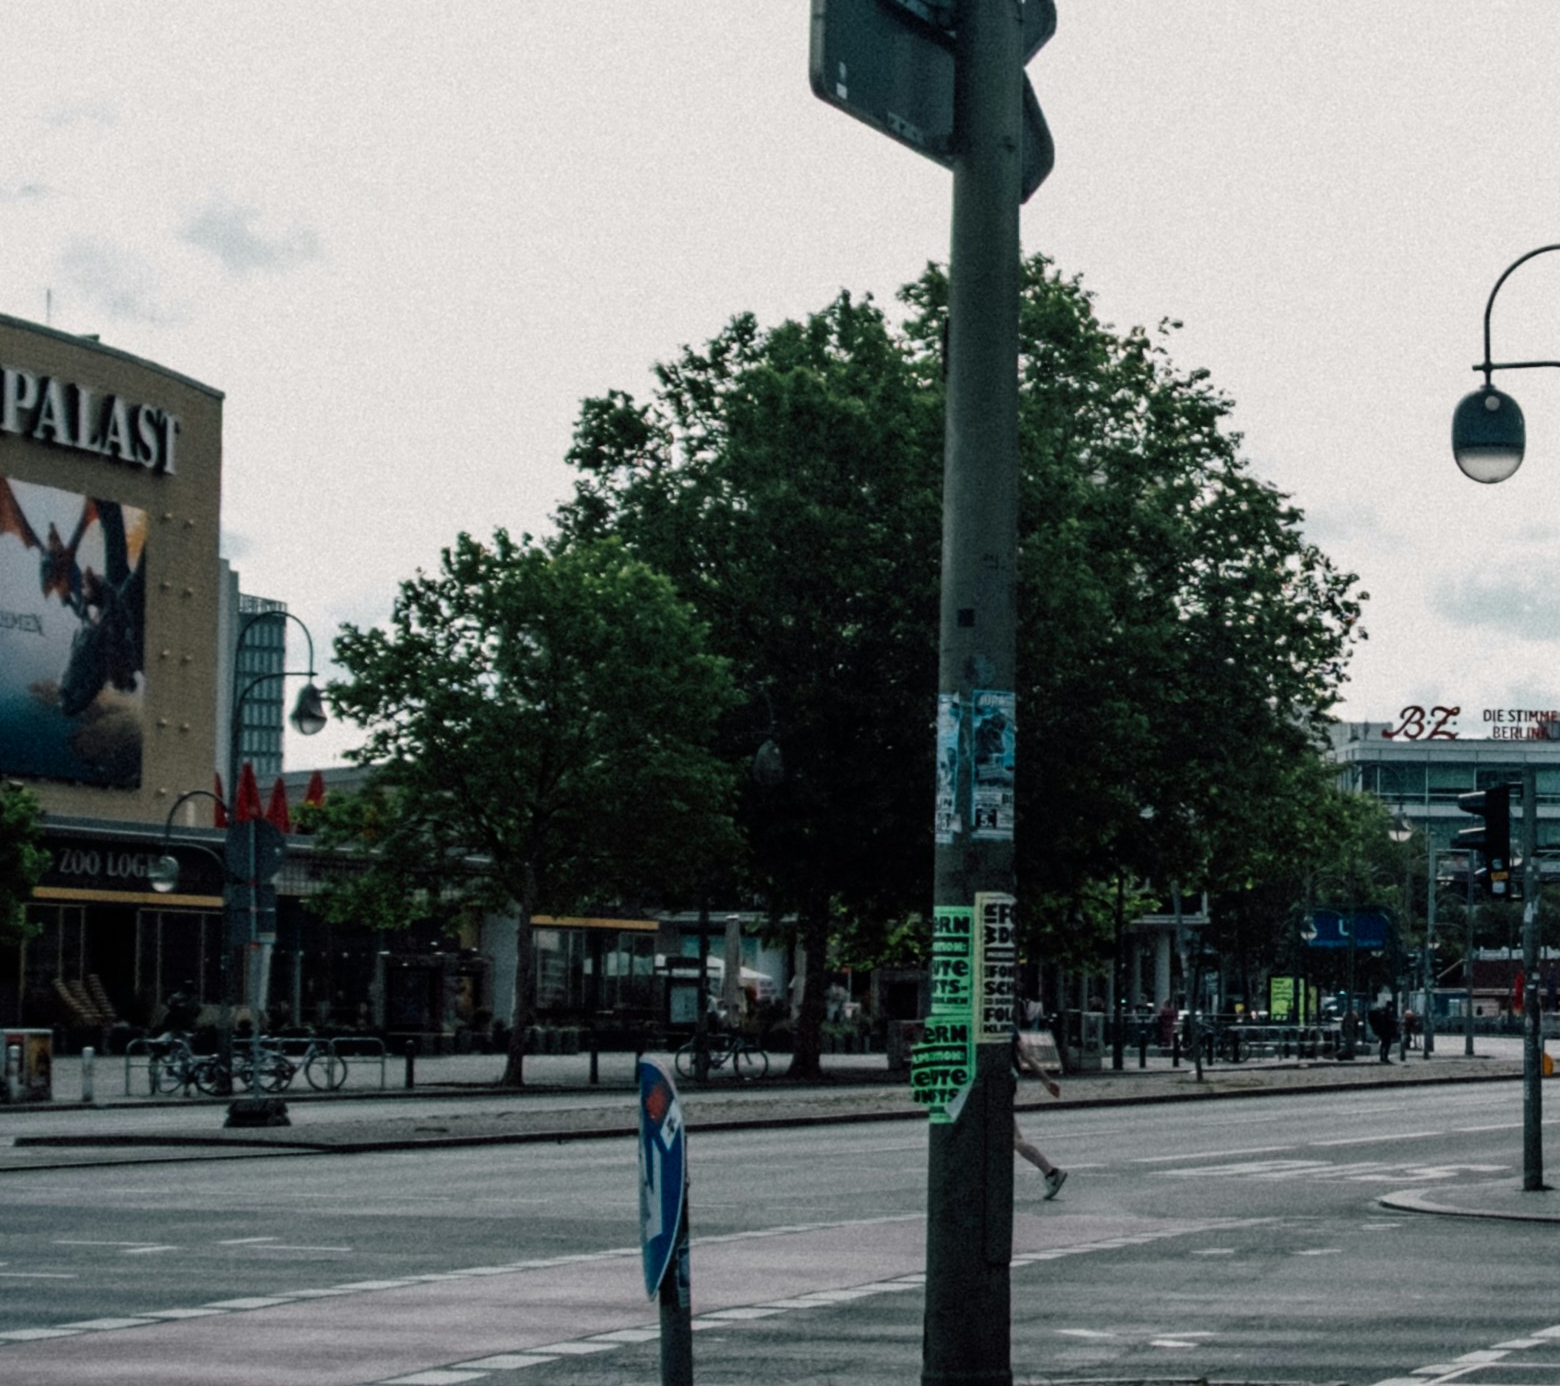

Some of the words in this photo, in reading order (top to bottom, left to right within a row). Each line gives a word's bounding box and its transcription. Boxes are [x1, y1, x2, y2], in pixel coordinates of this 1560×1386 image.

[1483, 709, 1504, 723] DIE
[1508, 709, 1558, 723] STIMME
[58, 846, 100, 876] ZOO
